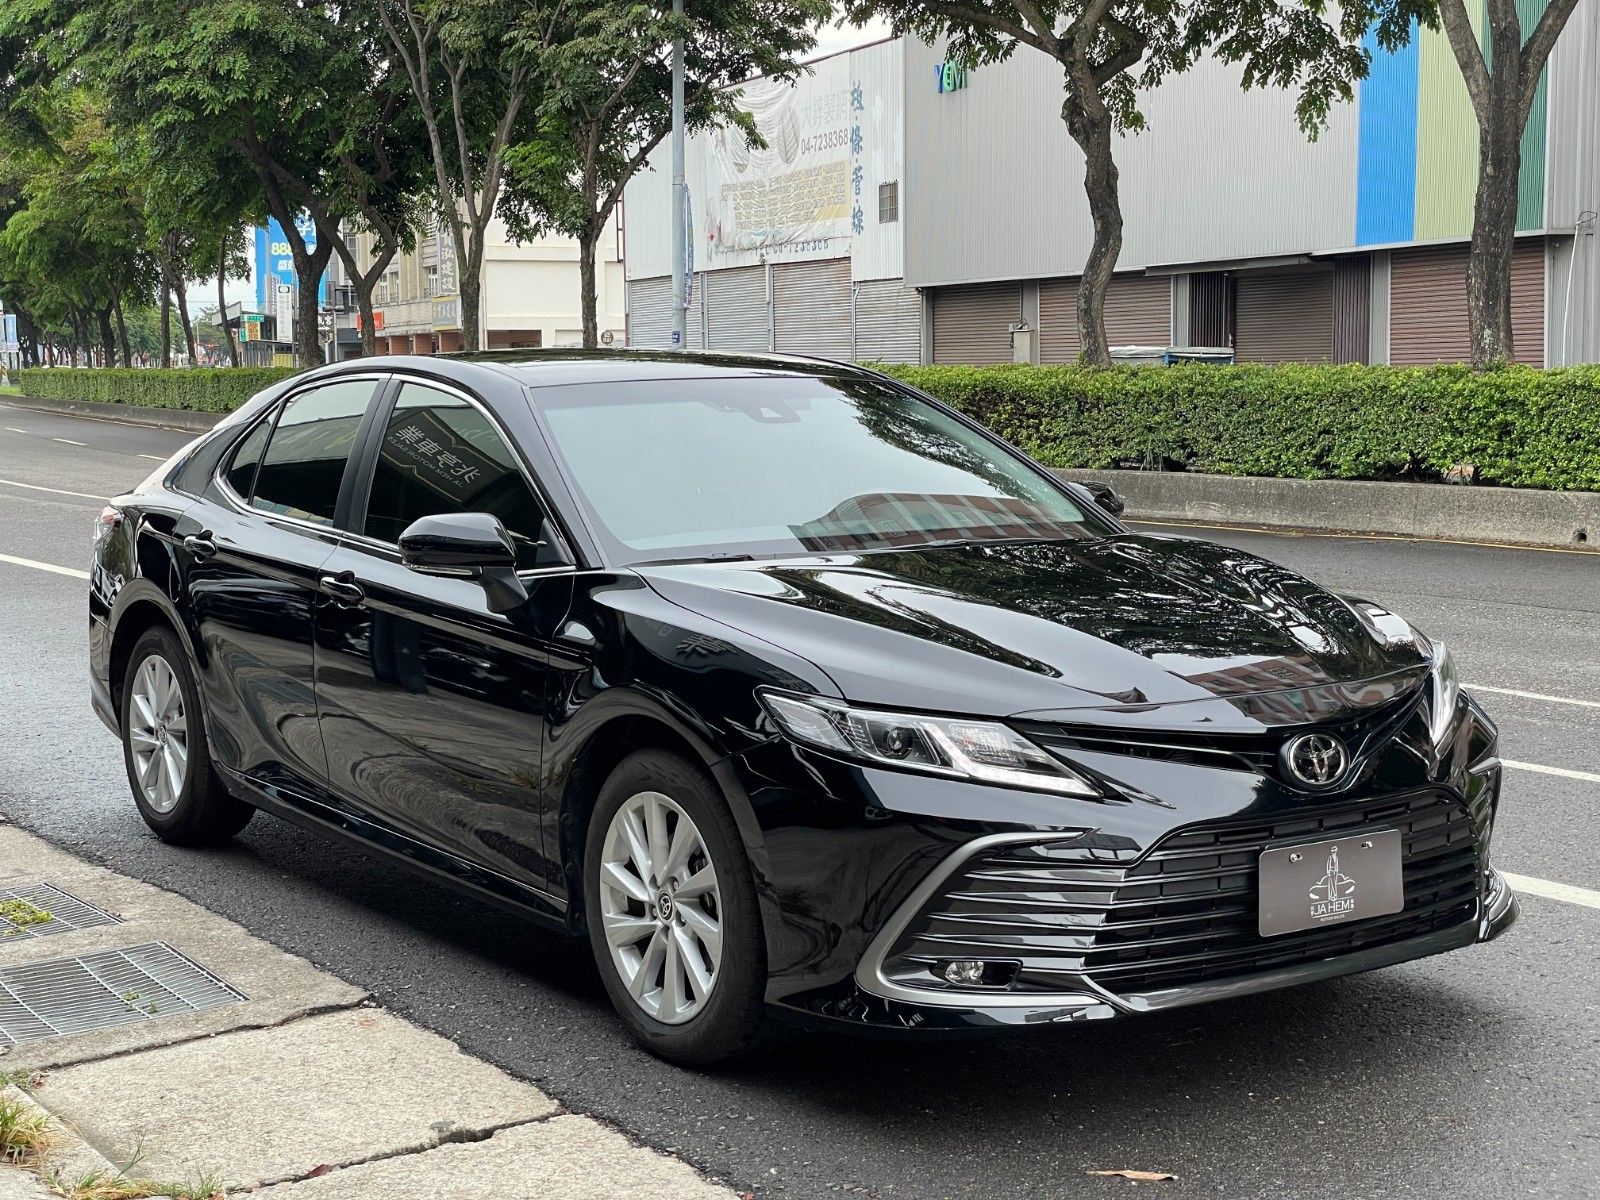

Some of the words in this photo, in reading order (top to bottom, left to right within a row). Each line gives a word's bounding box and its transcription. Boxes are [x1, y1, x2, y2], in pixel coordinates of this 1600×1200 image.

[801, 128, 849, 155] 04-7238368
[1313, 903, 1327, 915] JA
[1328, 899, 1350, 912] HEM
